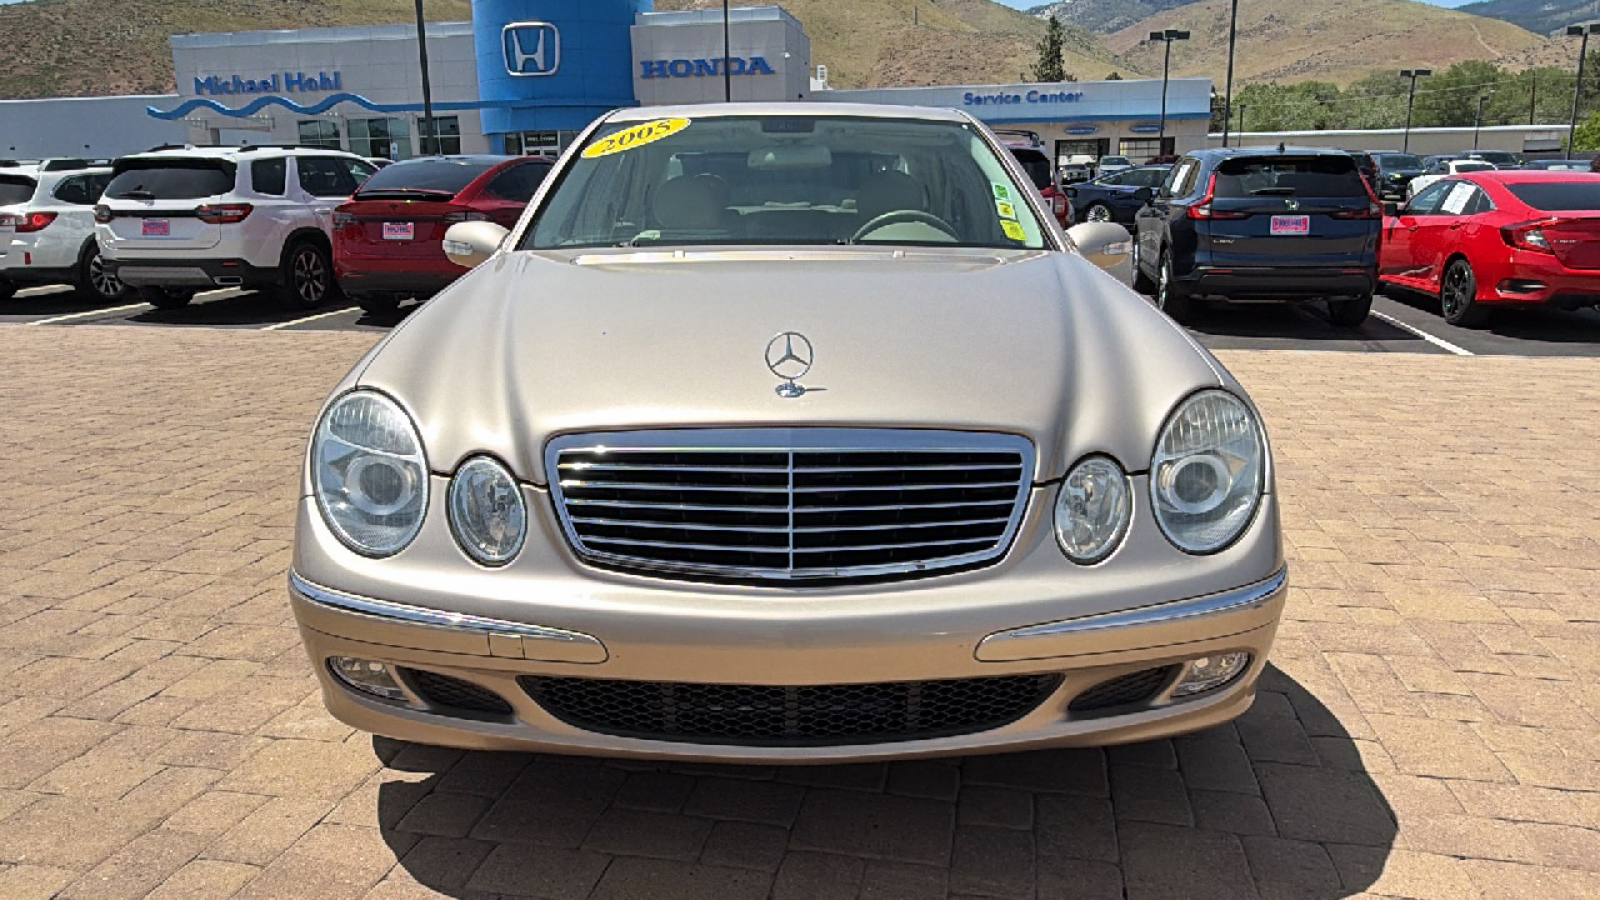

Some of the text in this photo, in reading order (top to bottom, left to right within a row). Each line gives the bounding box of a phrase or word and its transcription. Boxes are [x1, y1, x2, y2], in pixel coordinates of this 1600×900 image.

[640, 57, 775, 78] HONDA
[194, 71, 341, 95] Michael Hohl
[963, 90, 1083, 105] Service Center
[600, 119, 671, 153] 2005
